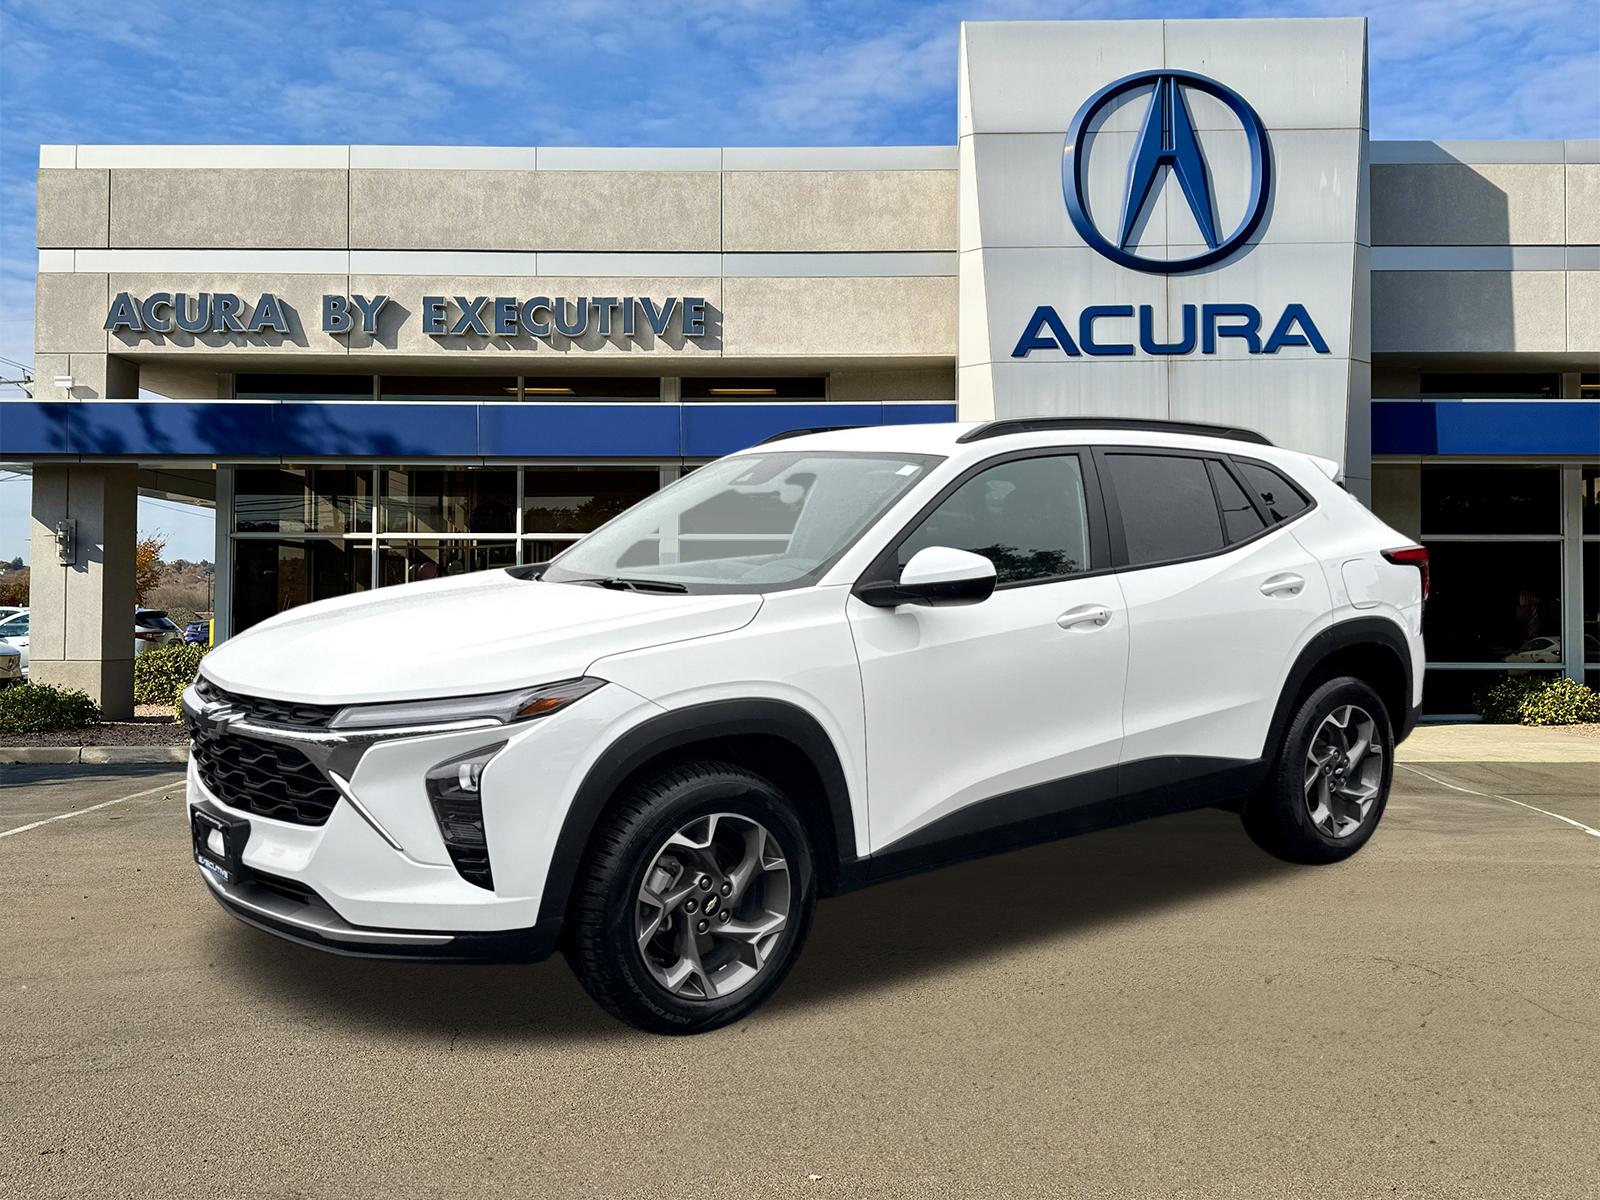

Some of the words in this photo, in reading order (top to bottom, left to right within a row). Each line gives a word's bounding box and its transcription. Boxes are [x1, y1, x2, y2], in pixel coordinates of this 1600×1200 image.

[103, 291, 289, 333] ACURA
[322, 294, 390, 335] BY
[421, 295, 706, 337] EXECUTIVE
[1010, 303, 1332, 357] ACURA
